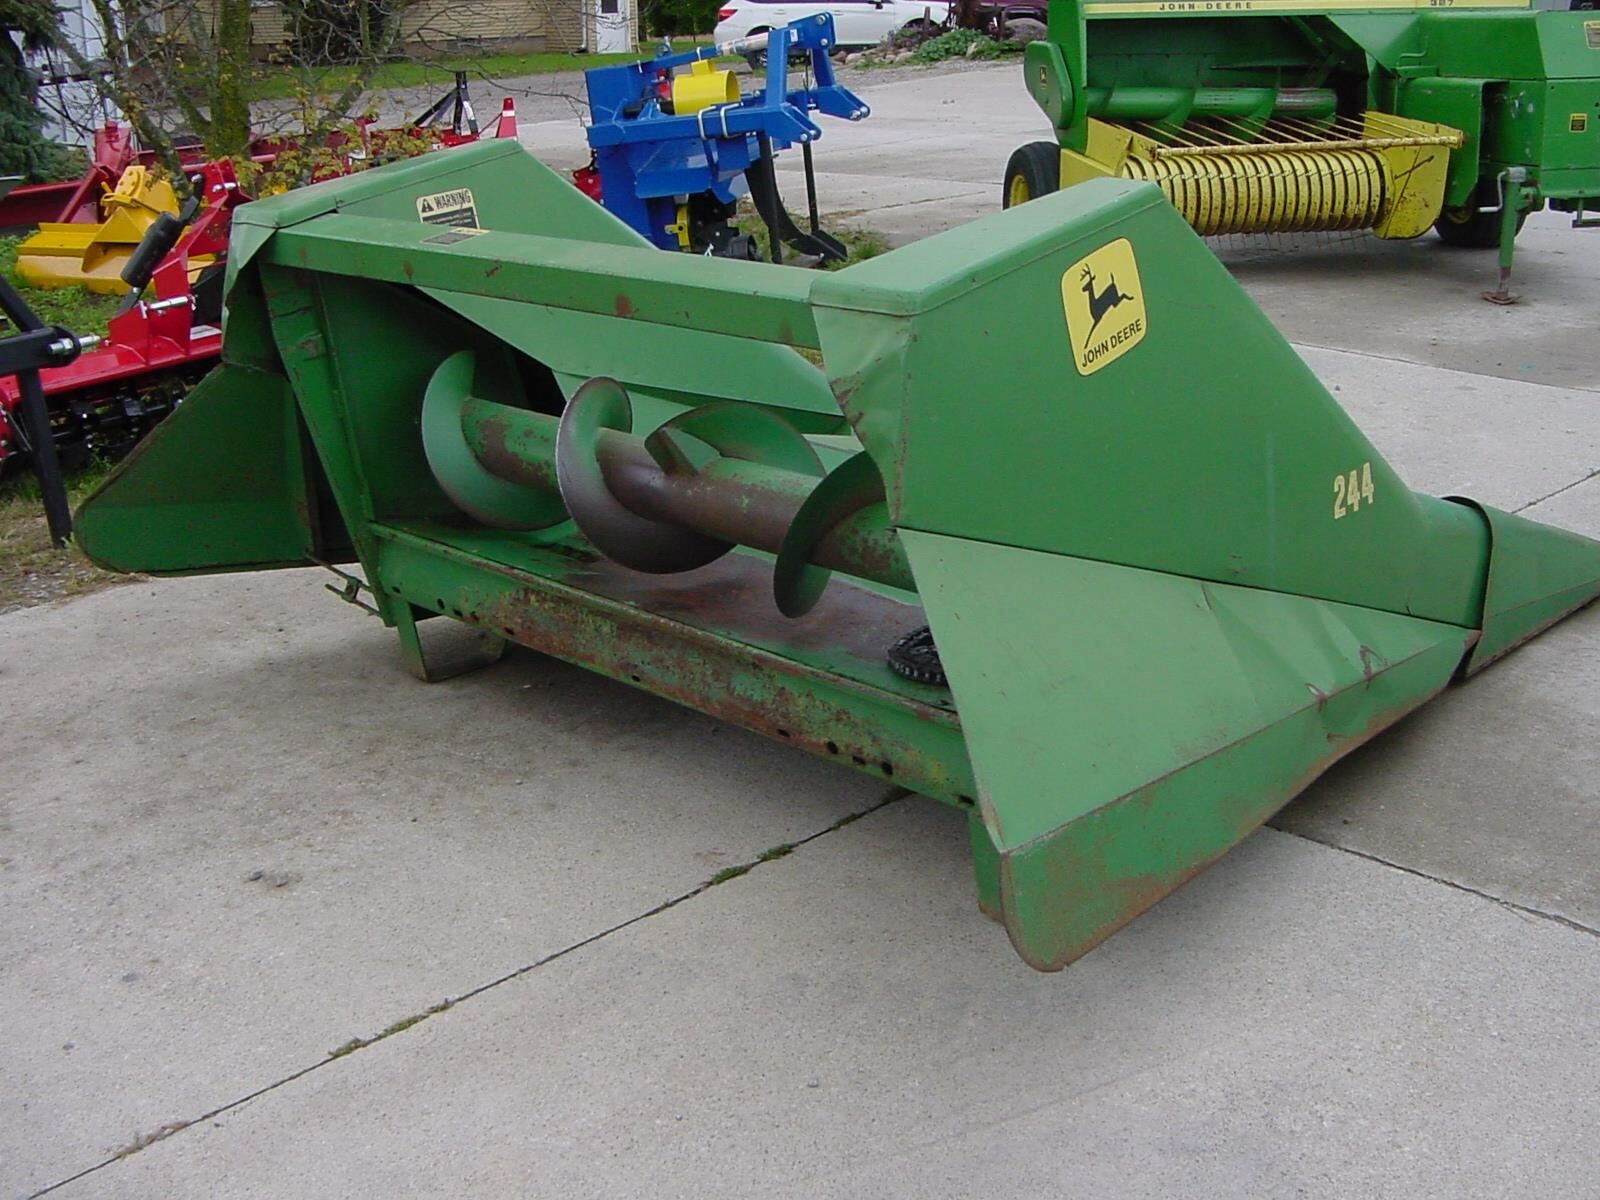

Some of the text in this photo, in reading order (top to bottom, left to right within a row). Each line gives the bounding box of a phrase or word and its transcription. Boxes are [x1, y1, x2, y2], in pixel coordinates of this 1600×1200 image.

[433, 190, 471, 209] WARNING
[1082, 319, 1142, 367] JOHN DEERE
[1334, 461, 1374, 519] 244
